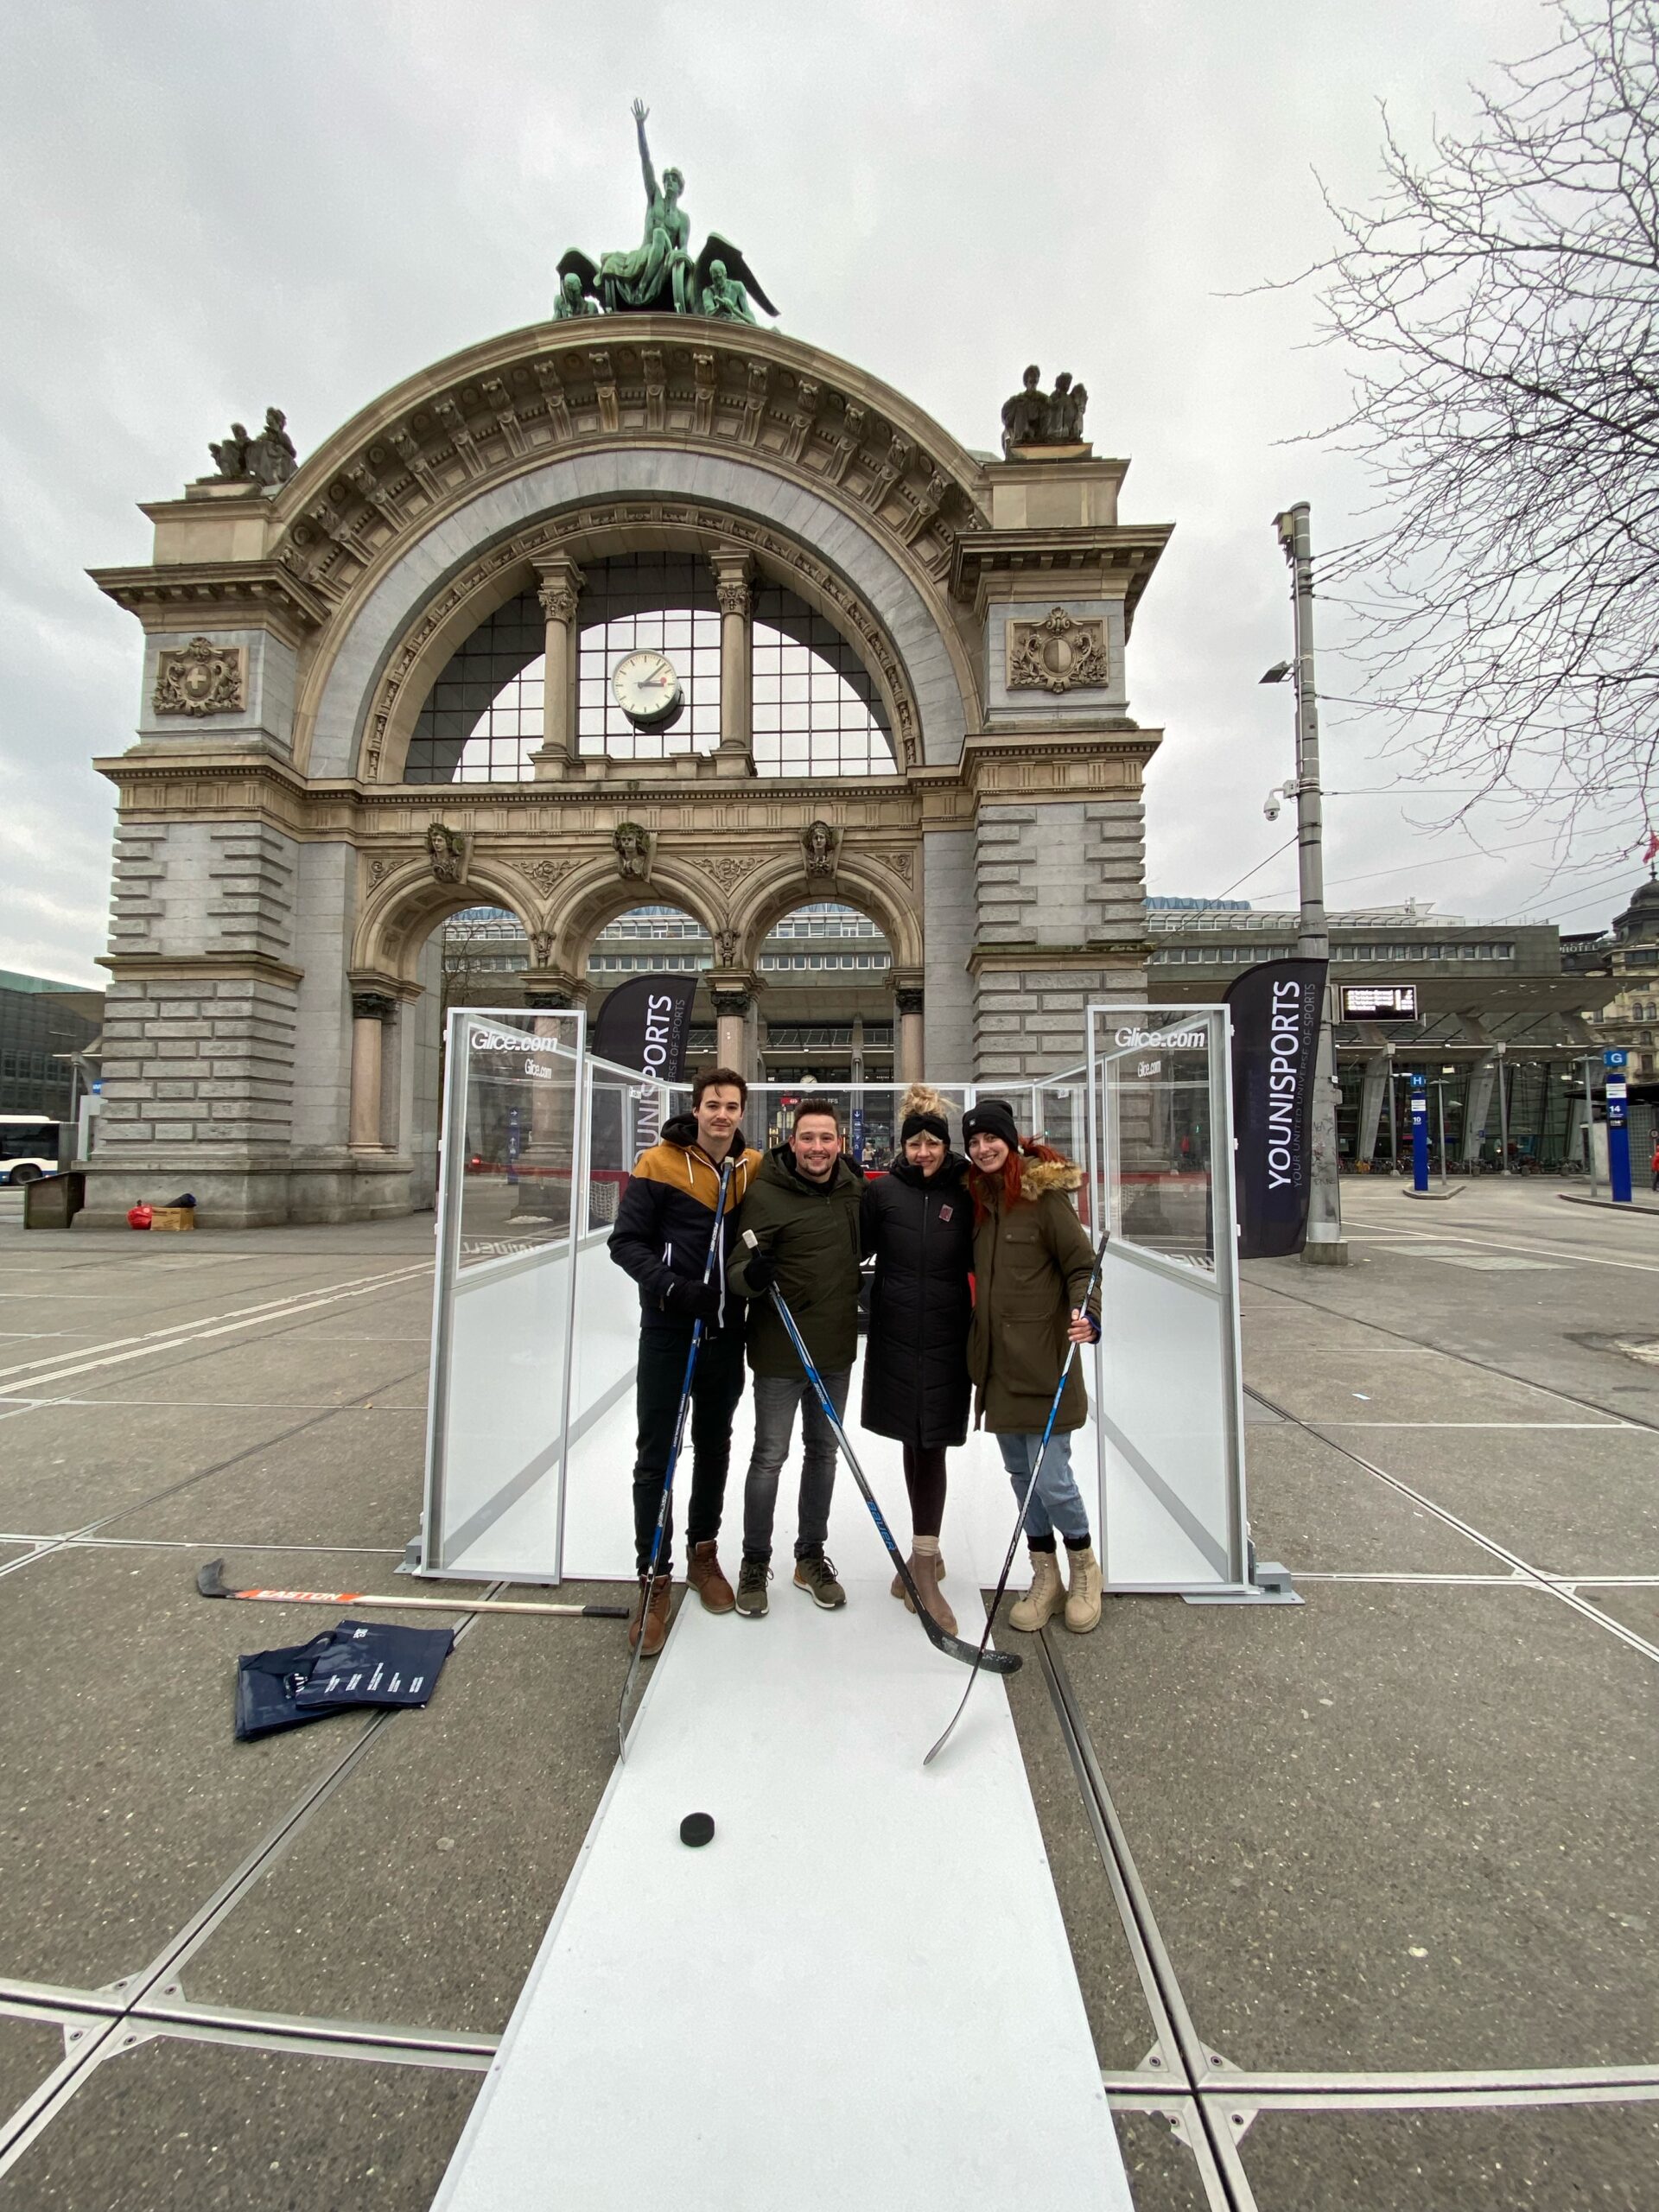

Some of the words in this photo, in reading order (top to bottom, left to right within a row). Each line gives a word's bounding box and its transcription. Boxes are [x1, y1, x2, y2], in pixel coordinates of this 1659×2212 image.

[1303, 982, 1315, 1027] SPORTS
[671, 999, 683, 1039] SPORTS
[471, 1029, 559, 1052] Glice.com
[670, 1040, 680, 1056] OF
[1114, 1027, 1205, 1048] Glice.com
[1302, 1028, 1312, 1046] OF
[1137, 1059, 1161, 1078] Glice.com
[1610, 1052, 1624, 1064] G
[633, 994, 672, 1166] UNISPORTS
[1268, 980, 1300, 1190] YOUNISPORTS
[1296, 1048, 1309, 1105] UNIVERSE
[1413, 1077, 1422, 1085] H
[1293, 1108, 1303, 1152] UNITED
[1292, 1154, 1303, 1187] YOUR
[257, 1590, 342, 1601] EASTON
